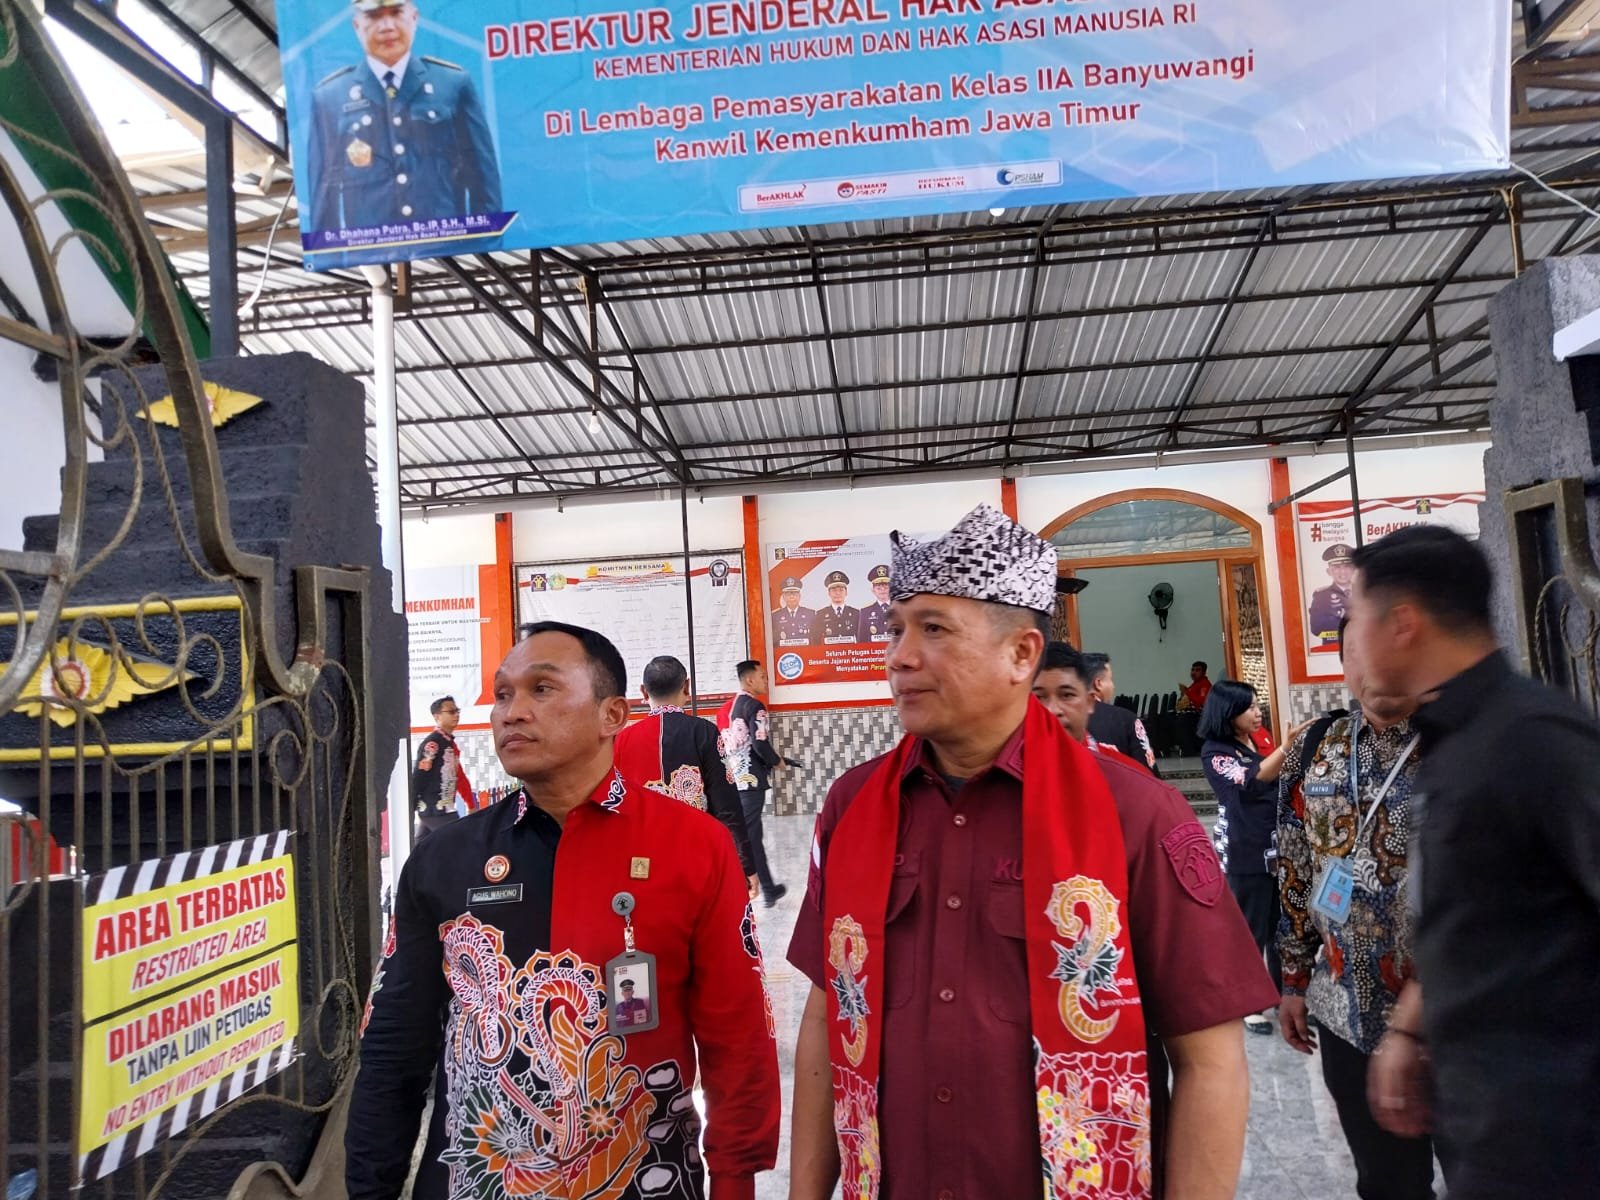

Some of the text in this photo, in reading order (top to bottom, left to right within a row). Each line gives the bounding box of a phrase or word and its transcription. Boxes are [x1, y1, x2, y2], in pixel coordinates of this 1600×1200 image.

[486, 9, 672, 58] DIREKTUR
[686, 0, 887, 37] JENDERAL
[595, 3, 1196, 79] KEMENTERIAN HUKUM DAN HAK ASASI MANUSIA RI
[546, 49, 1254, 136] Di Lembaga Pemasyarakatan Kelas IIA Banyuwangi
[656, 102, 1140, 162] Kanwil Kemenkumham Jawa Timur
[756, 190, 804, 202] BerAKHLAK
[94, 868, 286, 961] AREA TERBATAS
[132, 919, 267, 990] RESTRICTED AREA
[109, 960, 281, 1063] DILARANG MASUK
[127, 995, 272, 1085] TANPA IJIN PETUGAS
[103, 1021, 285, 1136] NO ENTRY WITHOUT PERMITTED
